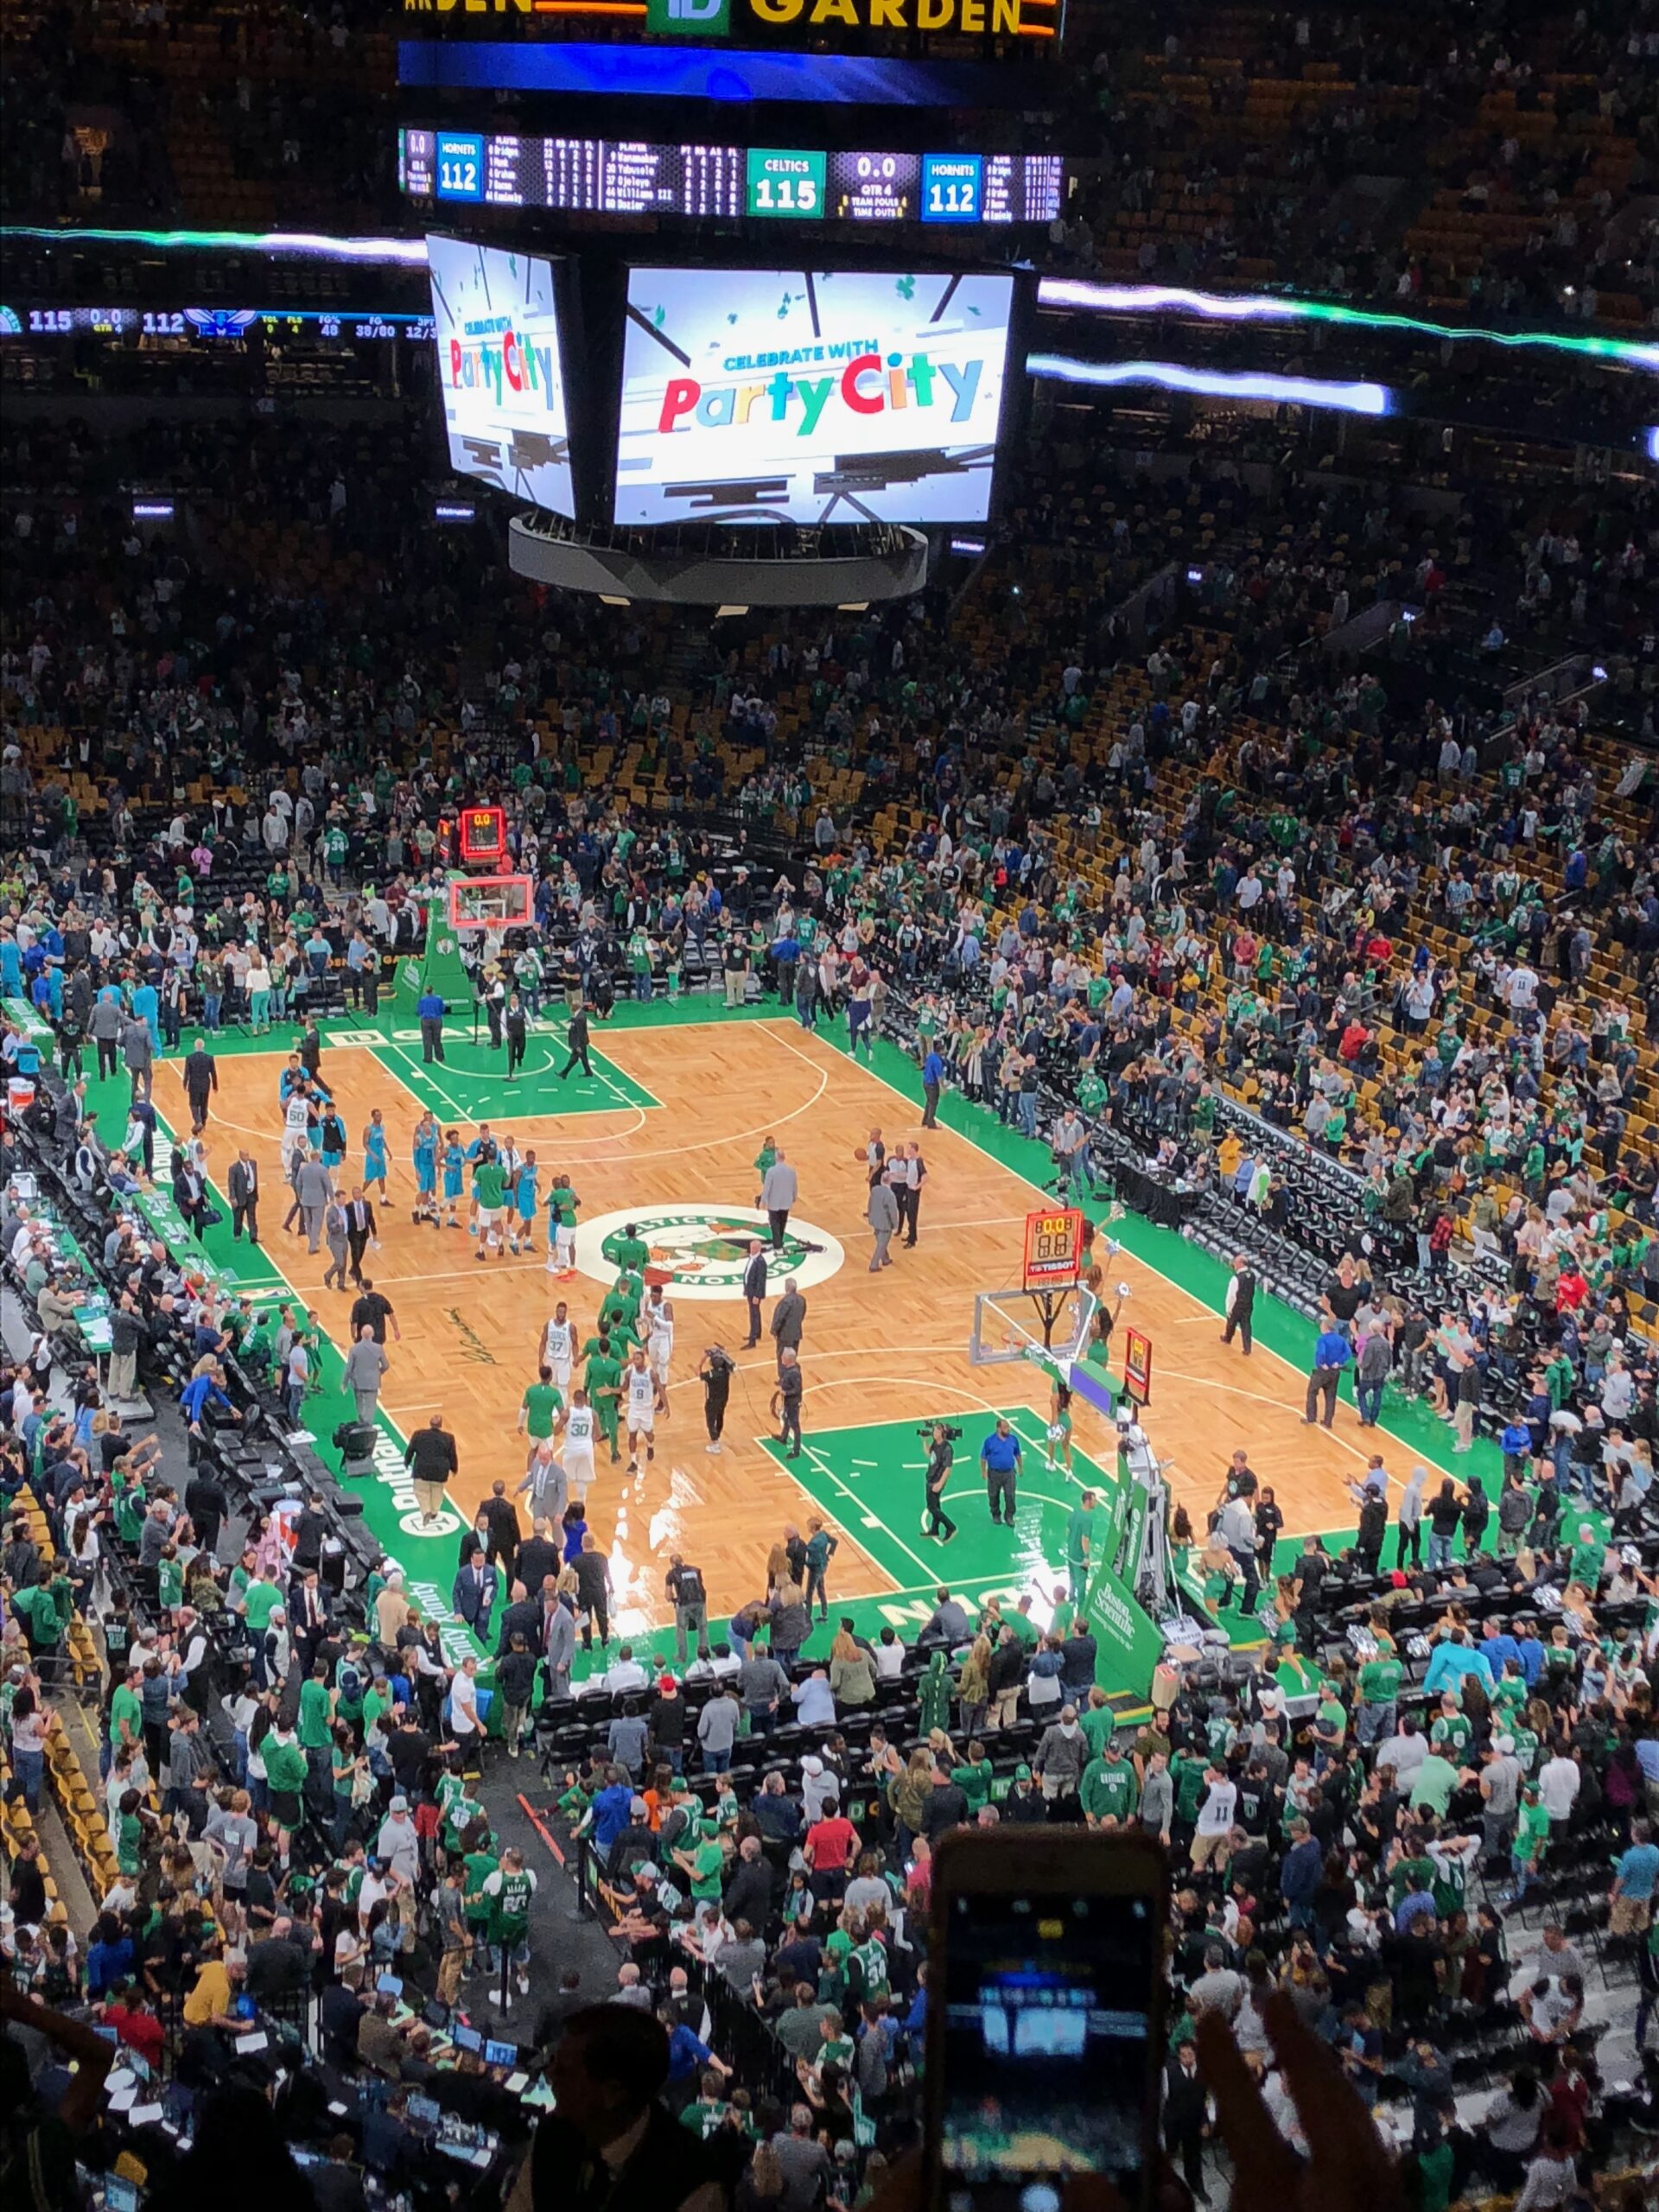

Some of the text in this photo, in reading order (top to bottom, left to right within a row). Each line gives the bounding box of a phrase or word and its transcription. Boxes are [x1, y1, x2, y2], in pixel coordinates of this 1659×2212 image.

[750, 0, 1020, 34] GARDEN
[442, 142, 476, 156] HORNETS
[619, 143, 646, 152] PLAYER
[764, 159, 809, 173] CELTICS
[857, 156, 896, 178] 0.0
[931, 164, 975, 176] HORNETS
[442, 162, 476, 192] 112
[606, 175, 616, 186] 37
[755, 179, 817, 210] 115
[861, 184, 892, 196] QTR 4
[851, 196, 873, 207] TEAM
[874, 198, 899, 207] FOULS
[929, 184, 974, 212] 112
[29, 309, 72, 331] 115
[90, 308, 122, 324] 0.0
[143, 312, 184, 333] 112
[369, 316, 382, 325] FG
[115, 323, 122, 333] 4
[291, 324, 299, 334] 4
[722, 338, 879, 372] CELEBRATE WITH
[474, 813, 491, 826] 0.0
[289, 1109, 305, 1122] 50
[549, 1340, 563, 1351] 37
[570, 1423, 589, 1437] 30
[1104, 1581, 1134, 1624] Boston
[1095, 1588, 1135, 1639] Scientific
